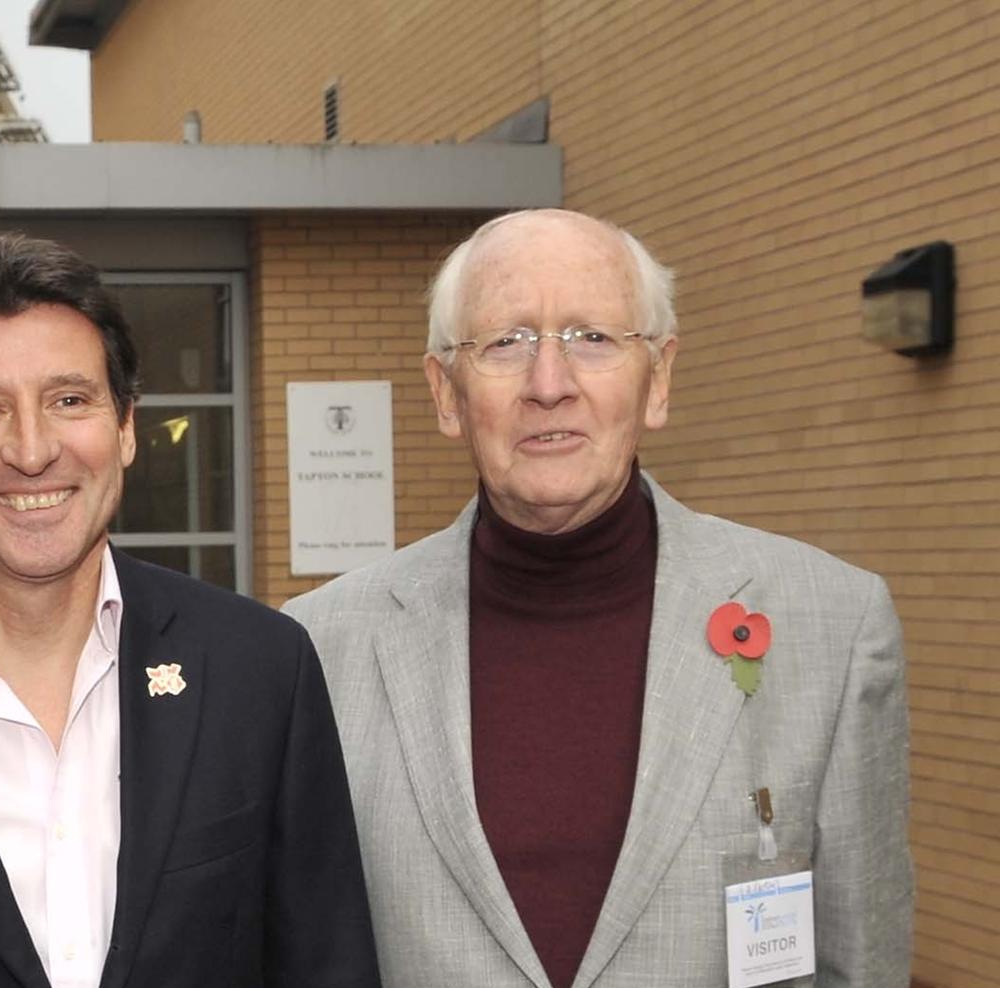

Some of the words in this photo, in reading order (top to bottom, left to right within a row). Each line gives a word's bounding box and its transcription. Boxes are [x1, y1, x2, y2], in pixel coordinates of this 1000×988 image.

[298, 472, 339, 481] TAPTON
[343, 471, 384, 480] SCHOOL
[746, 935, 797, 958] VISITOR
